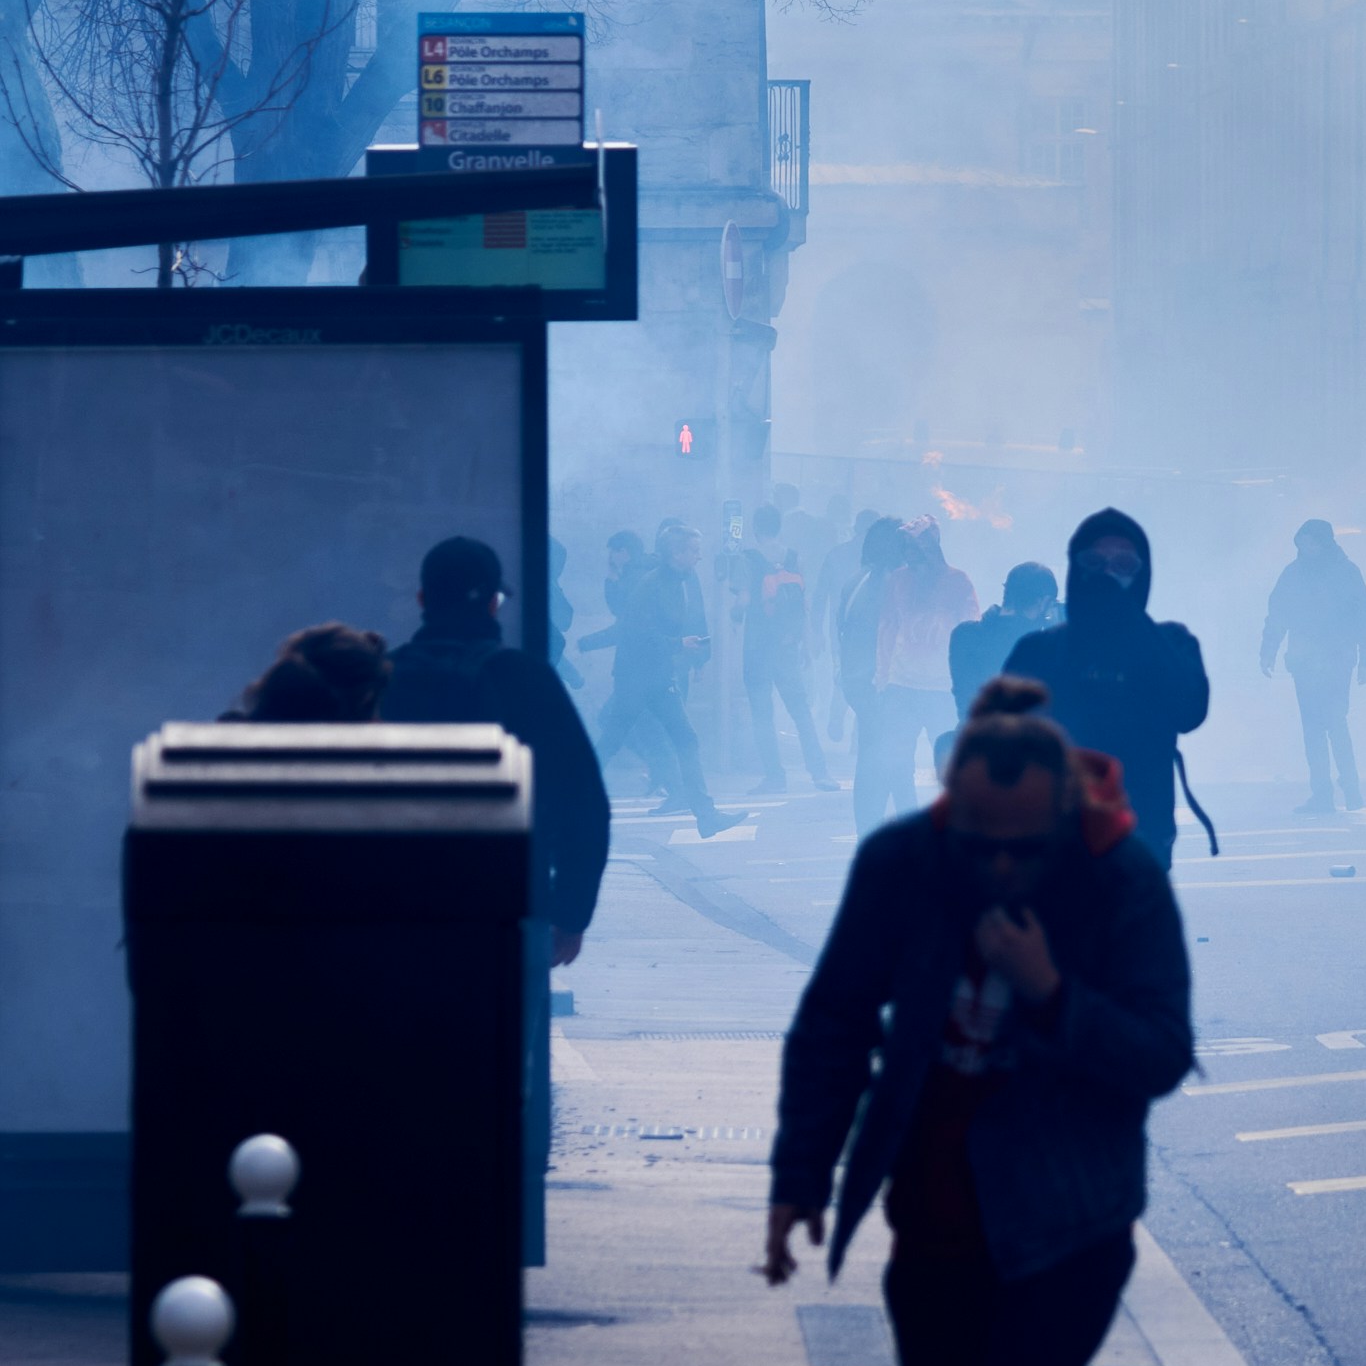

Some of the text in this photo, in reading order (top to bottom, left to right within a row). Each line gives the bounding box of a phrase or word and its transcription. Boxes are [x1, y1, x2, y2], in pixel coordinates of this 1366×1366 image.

[424, 41, 549, 61] L4 Pôle Orchamps
[424, 68, 549, 89] L6 Pôle Orchamps
[424, 97, 445, 113] 10
[449, 100, 523, 117] Chaffanjon
[449, 128, 511, 143] Citadelle
[448, 150, 555, 171] Granvelle
[202, 323, 322, 344] JCDecaux
